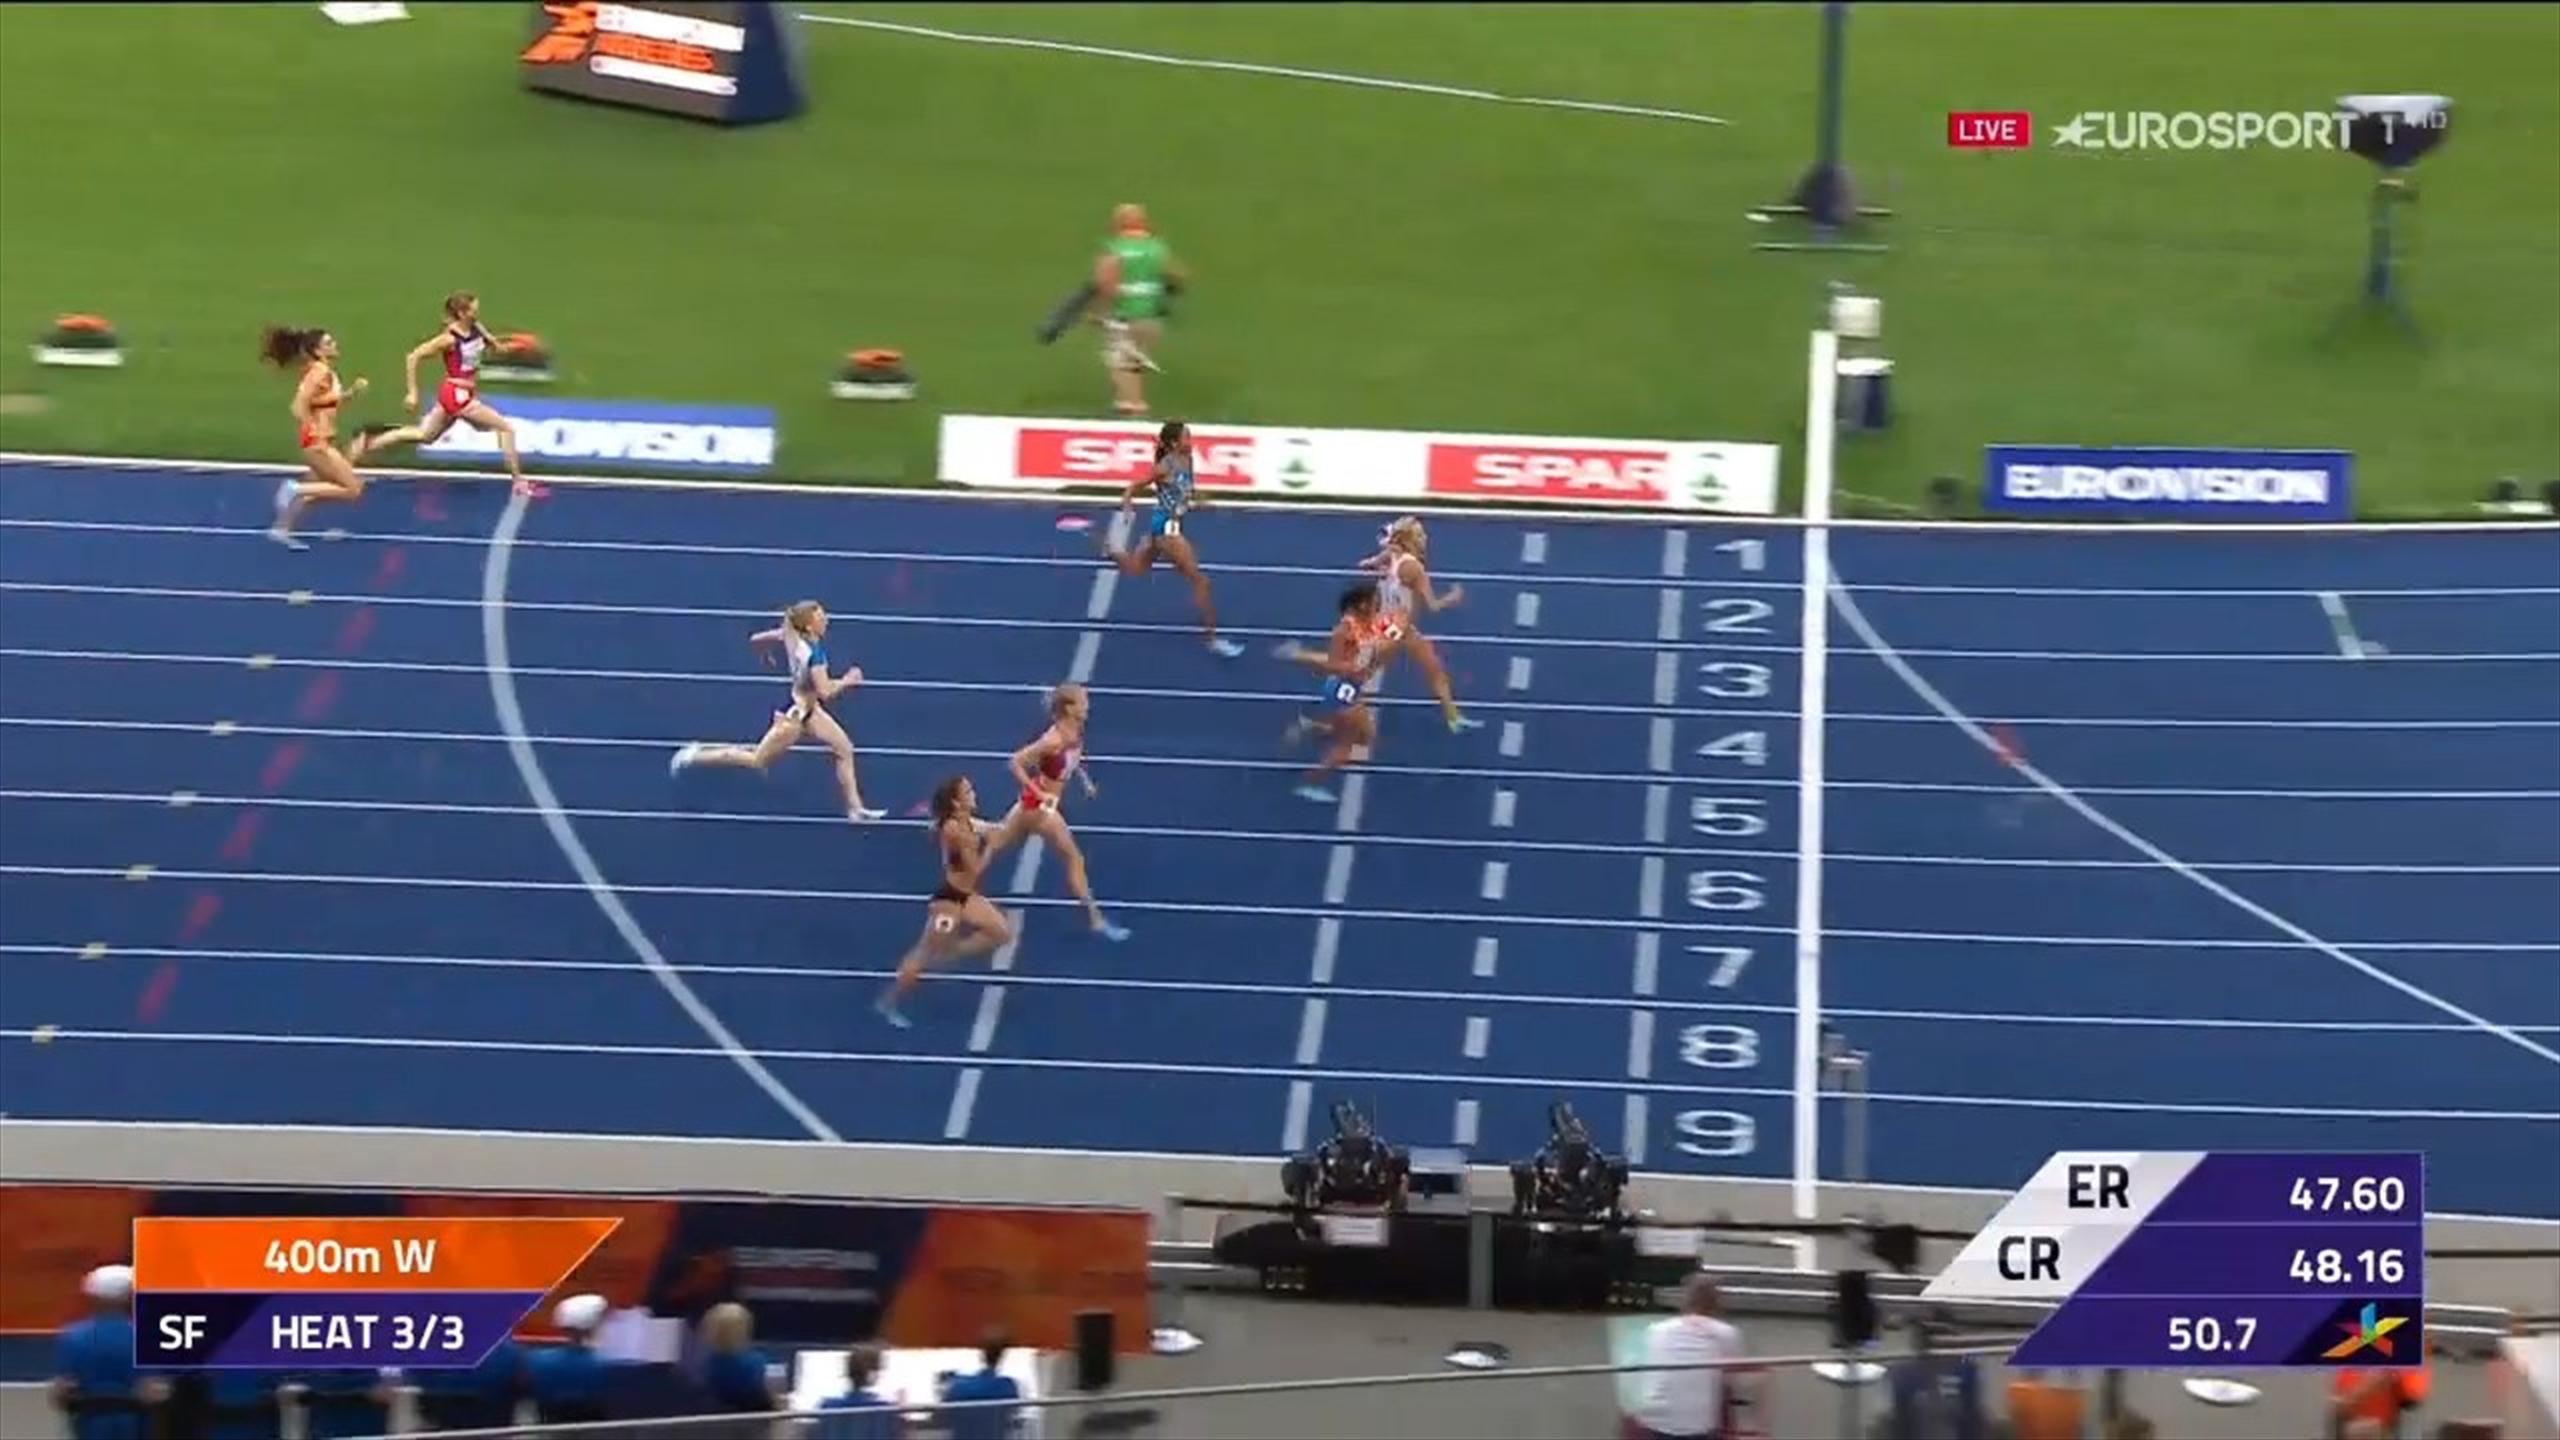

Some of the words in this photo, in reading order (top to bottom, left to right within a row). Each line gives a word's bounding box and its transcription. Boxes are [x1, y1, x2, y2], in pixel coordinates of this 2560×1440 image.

[1472, 453, 1666, 493] SPAR
[2004, 464, 2329, 504] EUROVISION
[1713, 539, 1766, 571] 1
[1700, 598, 1774, 633] 2
[1698, 662, 1772, 697] 3
[1696, 731, 1769, 766] 4
[1691, 797, 1768, 836] 5
[1688, 870, 1767, 910] 6
[1683, 946, 1755, 988] 7
[1679, 1024, 1760, 1069] 8
[1675, 1109, 1755, 1156] 9
